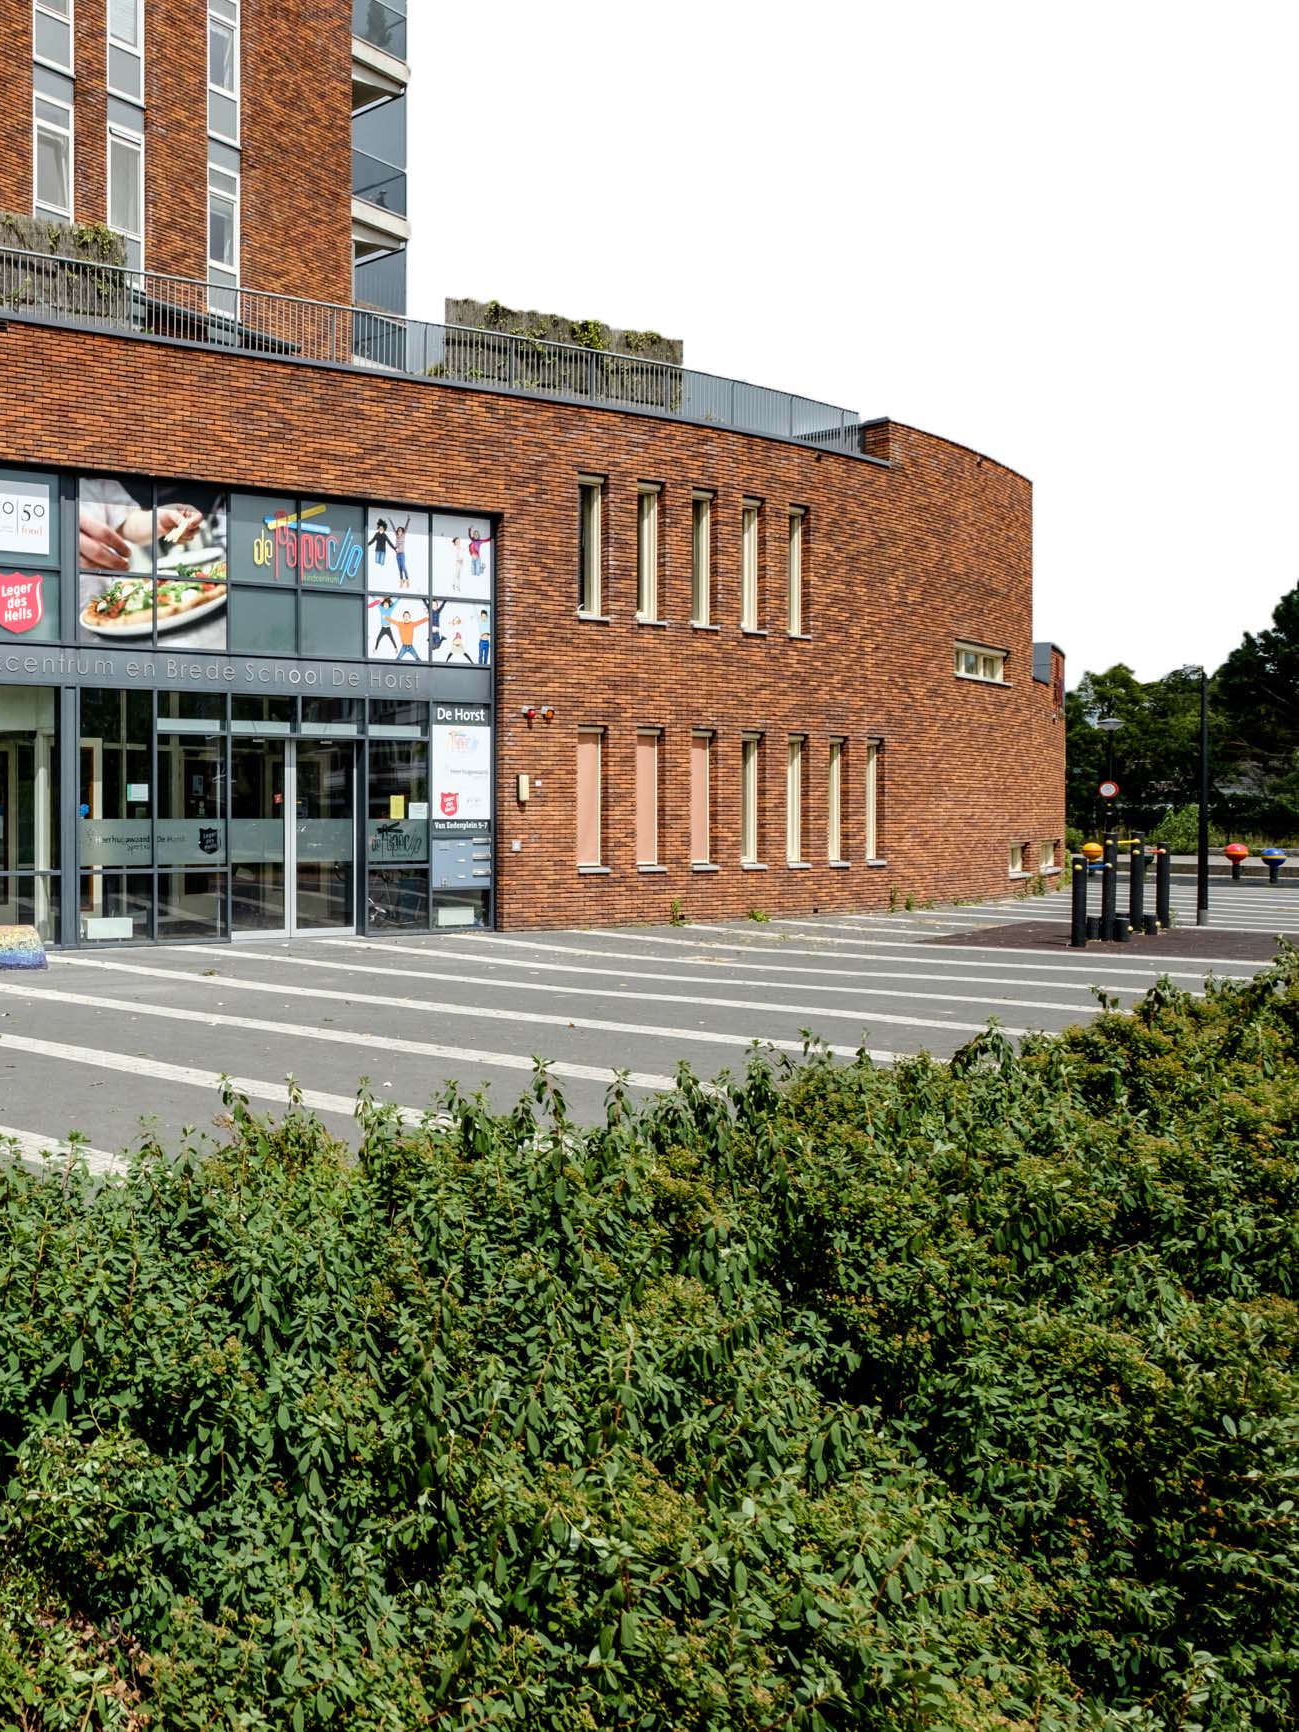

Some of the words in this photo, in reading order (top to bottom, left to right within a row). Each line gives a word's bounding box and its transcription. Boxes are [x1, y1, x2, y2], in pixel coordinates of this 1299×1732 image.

[0, 582, 33, 598] Leger
[7, 596, 28, 609] des
[126, 661, 157, 677] en
[166, 659, 237, 682] Brede
[244, 663, 323, 686] School
[332, 667, 361, 688] De
[369, 669, 422, 690] Horst
[437, 707, 453, 720] De
[454, 708, 486, 722] Horst
